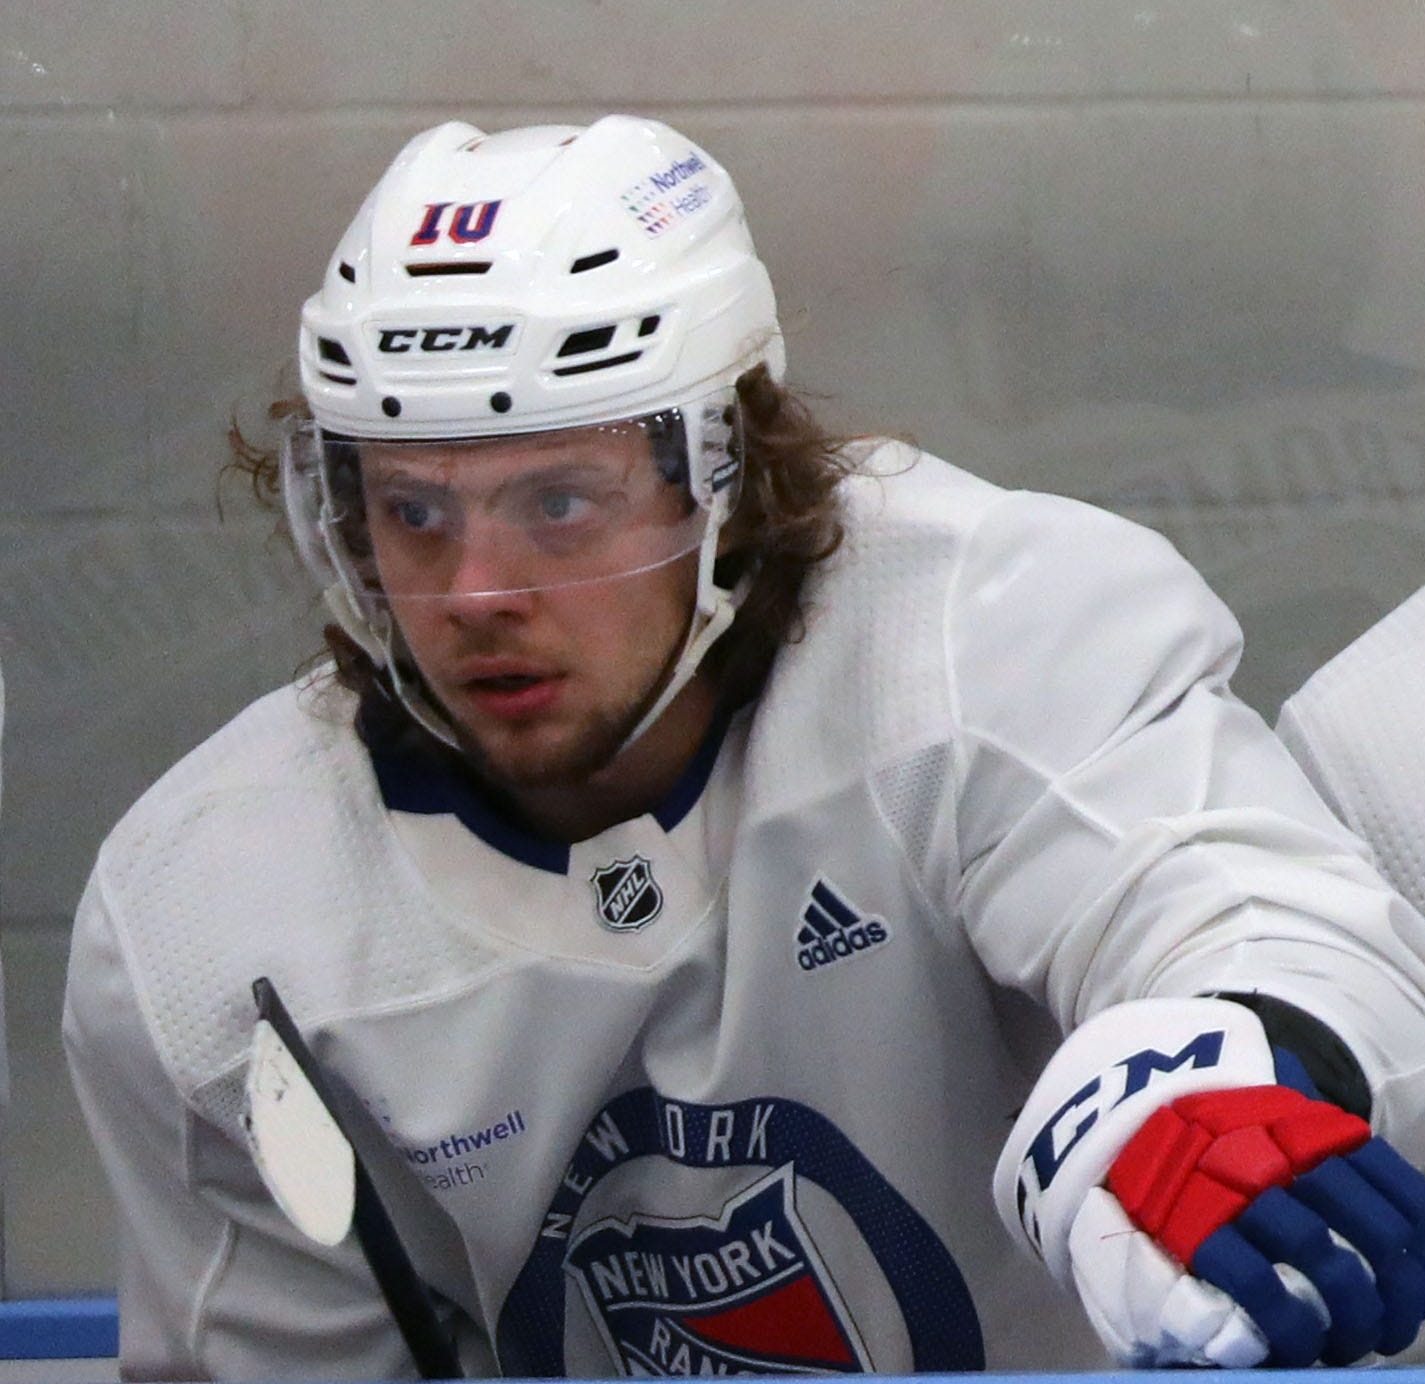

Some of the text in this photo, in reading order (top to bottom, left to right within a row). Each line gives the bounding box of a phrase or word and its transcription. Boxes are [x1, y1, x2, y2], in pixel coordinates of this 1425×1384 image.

[378, 323, 516, 353] CCM
[609, 869, 647, 921] NHL
[797, 920, 888, 971] adidas
[423, 1162, 486, 1190] ealth
[541, 1102, 776, 1240] NEW ORK
[590, 1218, 797, 1303] NEW YORK
